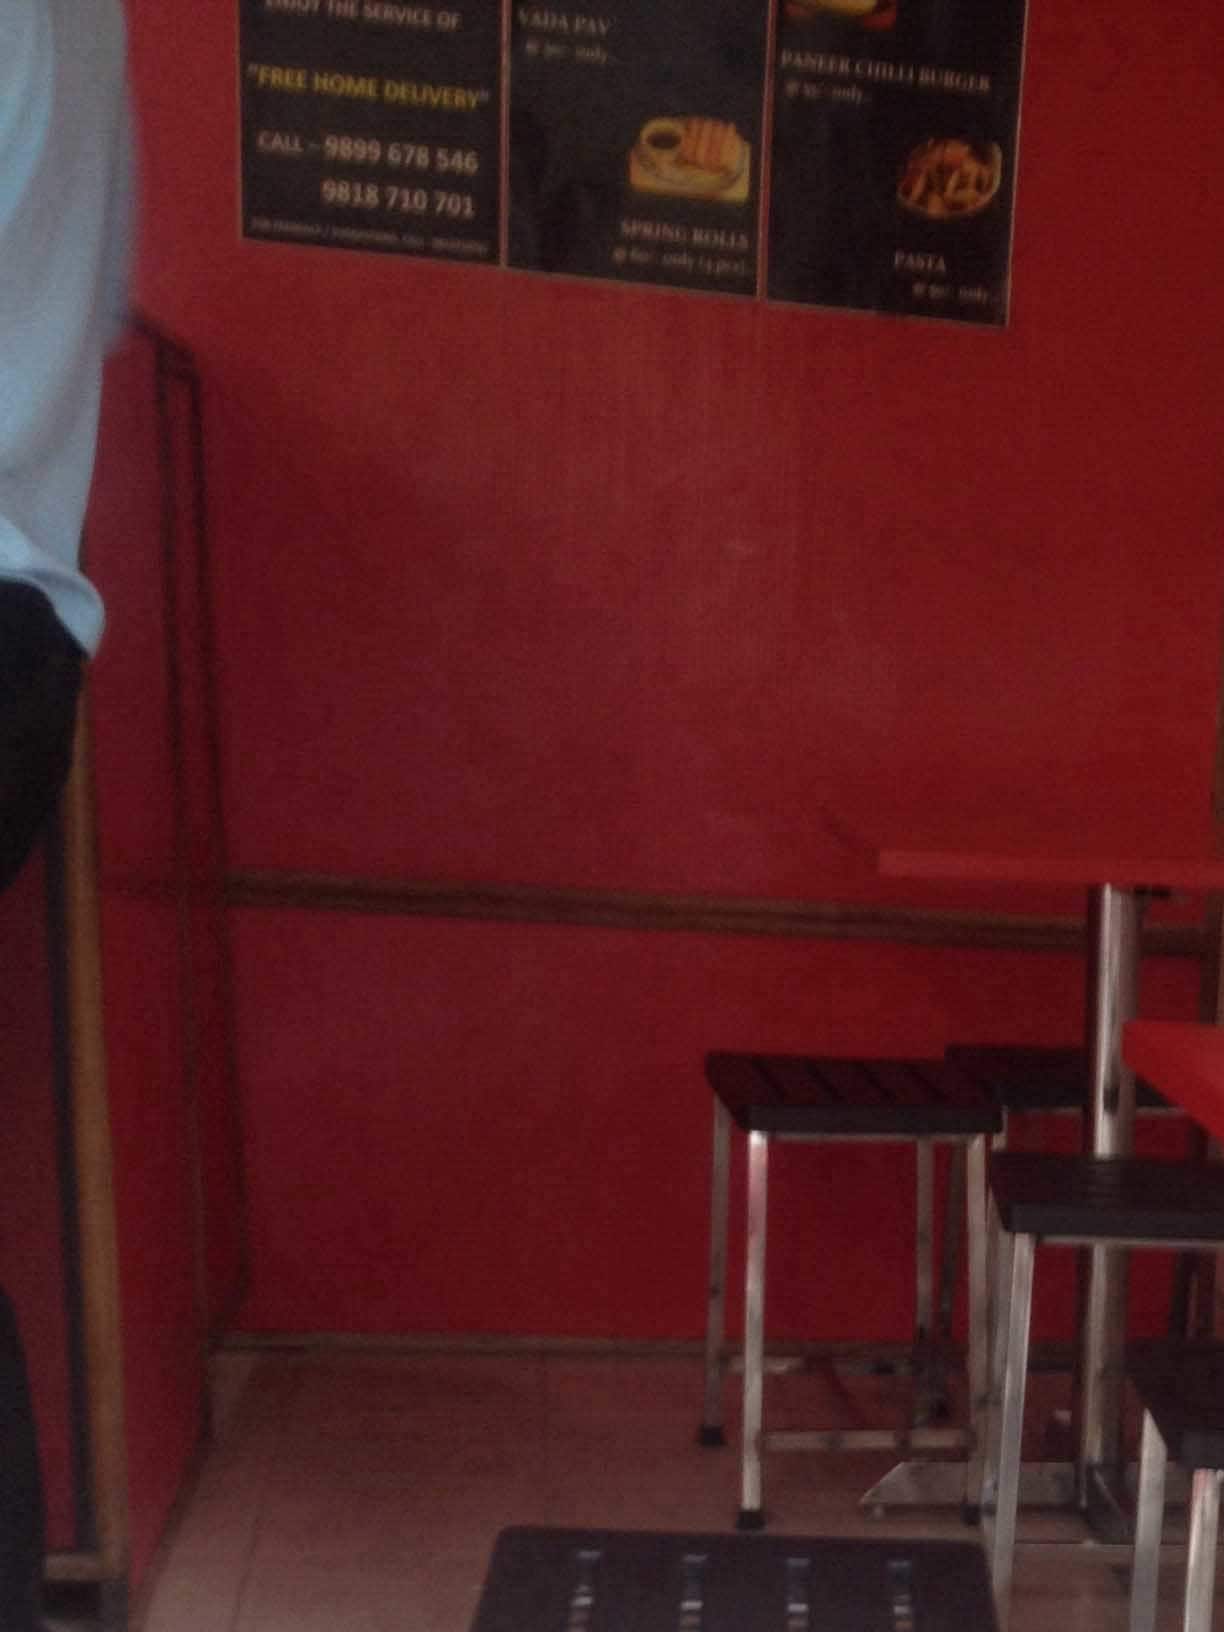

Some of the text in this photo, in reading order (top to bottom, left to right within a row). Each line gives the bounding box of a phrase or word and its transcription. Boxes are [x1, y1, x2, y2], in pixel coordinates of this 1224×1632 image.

[363, 2, 431, 26] SERVICE
[436, 12, 461, 30] OF
[313, 71, 379, 98] HOME
[781, 50, 851, 75] PANEER
[918, 67, 991, 92] BURGER
[256, 130, 303, 153] CALL
[323, 134, 382, 162] 9899
[386, 142, 430, 169] 678
[434, 147, 479, 176] 546
[321, 178, 475, 220] 9818 710 701
[621, 218, 685, 242] SPRING
[894, 250, 946, 273] PASTA
